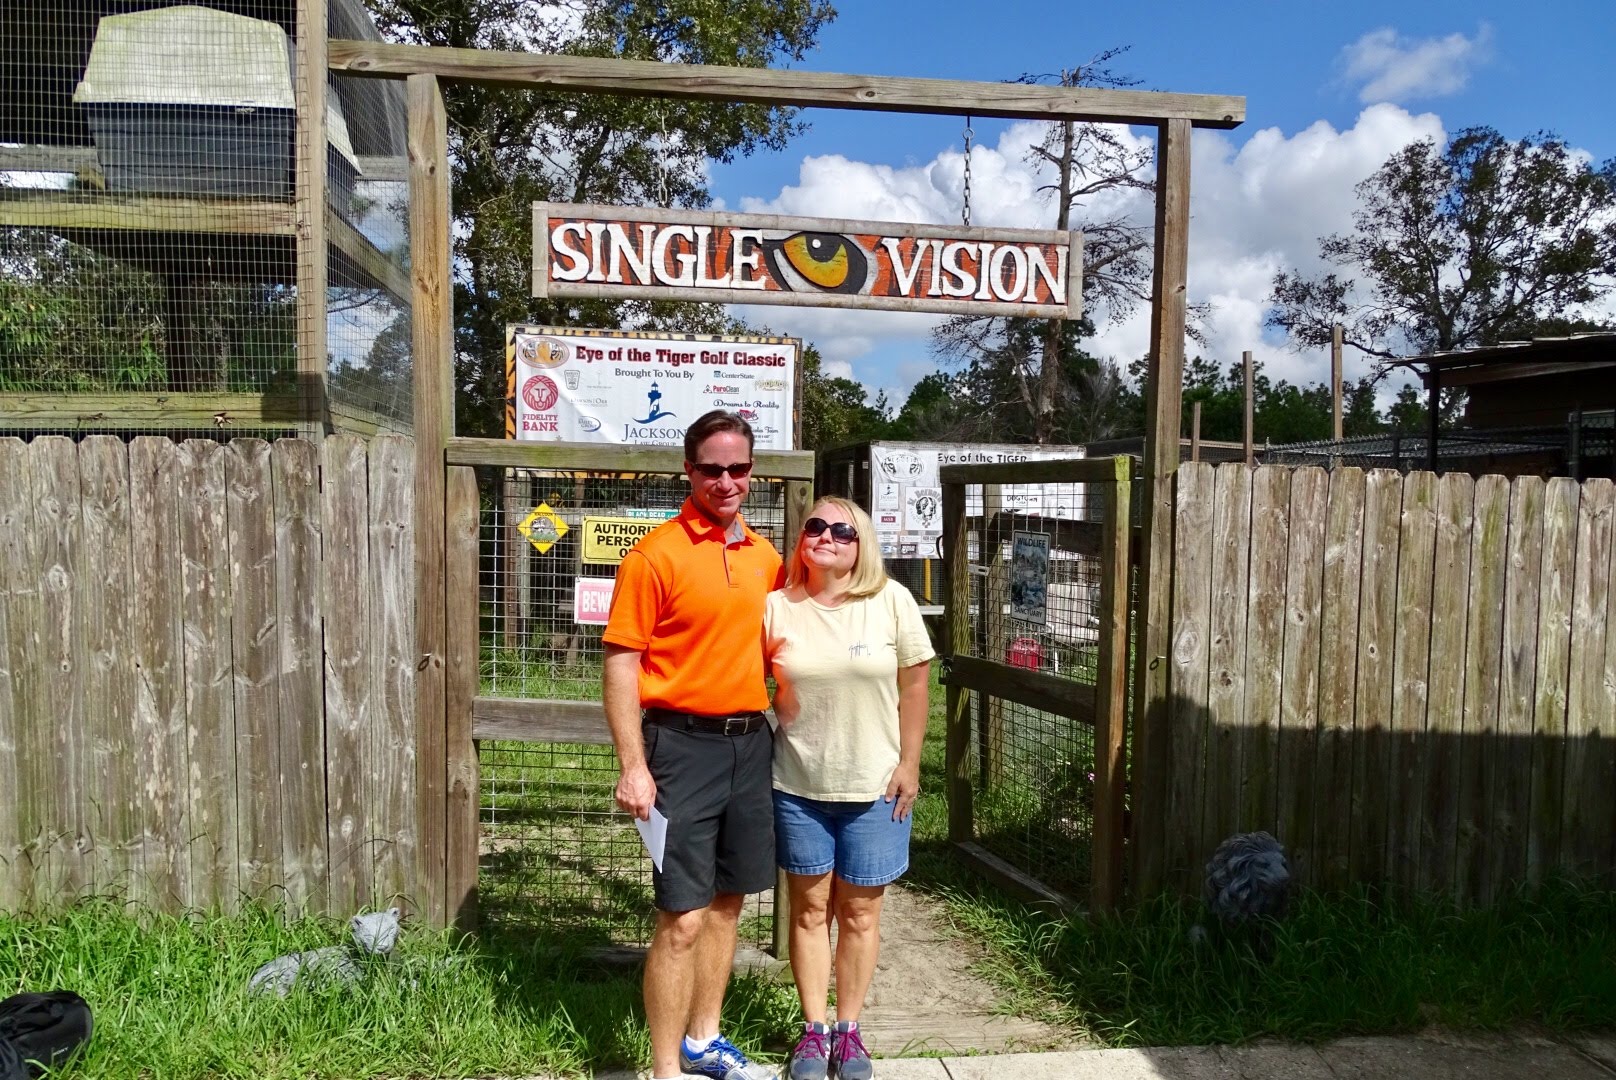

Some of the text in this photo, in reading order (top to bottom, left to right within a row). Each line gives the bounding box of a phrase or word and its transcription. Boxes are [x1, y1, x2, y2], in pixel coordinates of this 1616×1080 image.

[549, 221, 1069, 305] SINGLE VISION
[576, 346, 603, 363] Eye
[608, 347, 622, 361] of
[627, 348, 651, 362] the
[656, 349, 695, 367] Tiger
[700, 351, 728, 365] Golf
[733, 352, 786, 367] Classic
[615, 368, 695, 380] Brought To You By
[713, 399, 743, 408] Dreams
[753, 400, 780, 409] Reality
[522, 421, 558, 432] BANK
[938, 453, 956, 463] Eye
[960, 453, 972, 462] of
[975, 453, 993, 463] the
[594, 523, 659, 536] AUTHORI
[1016, 536, 1046, 549] WILDLIFE
[1014, 606, 1043, 619] SANCTUARY
